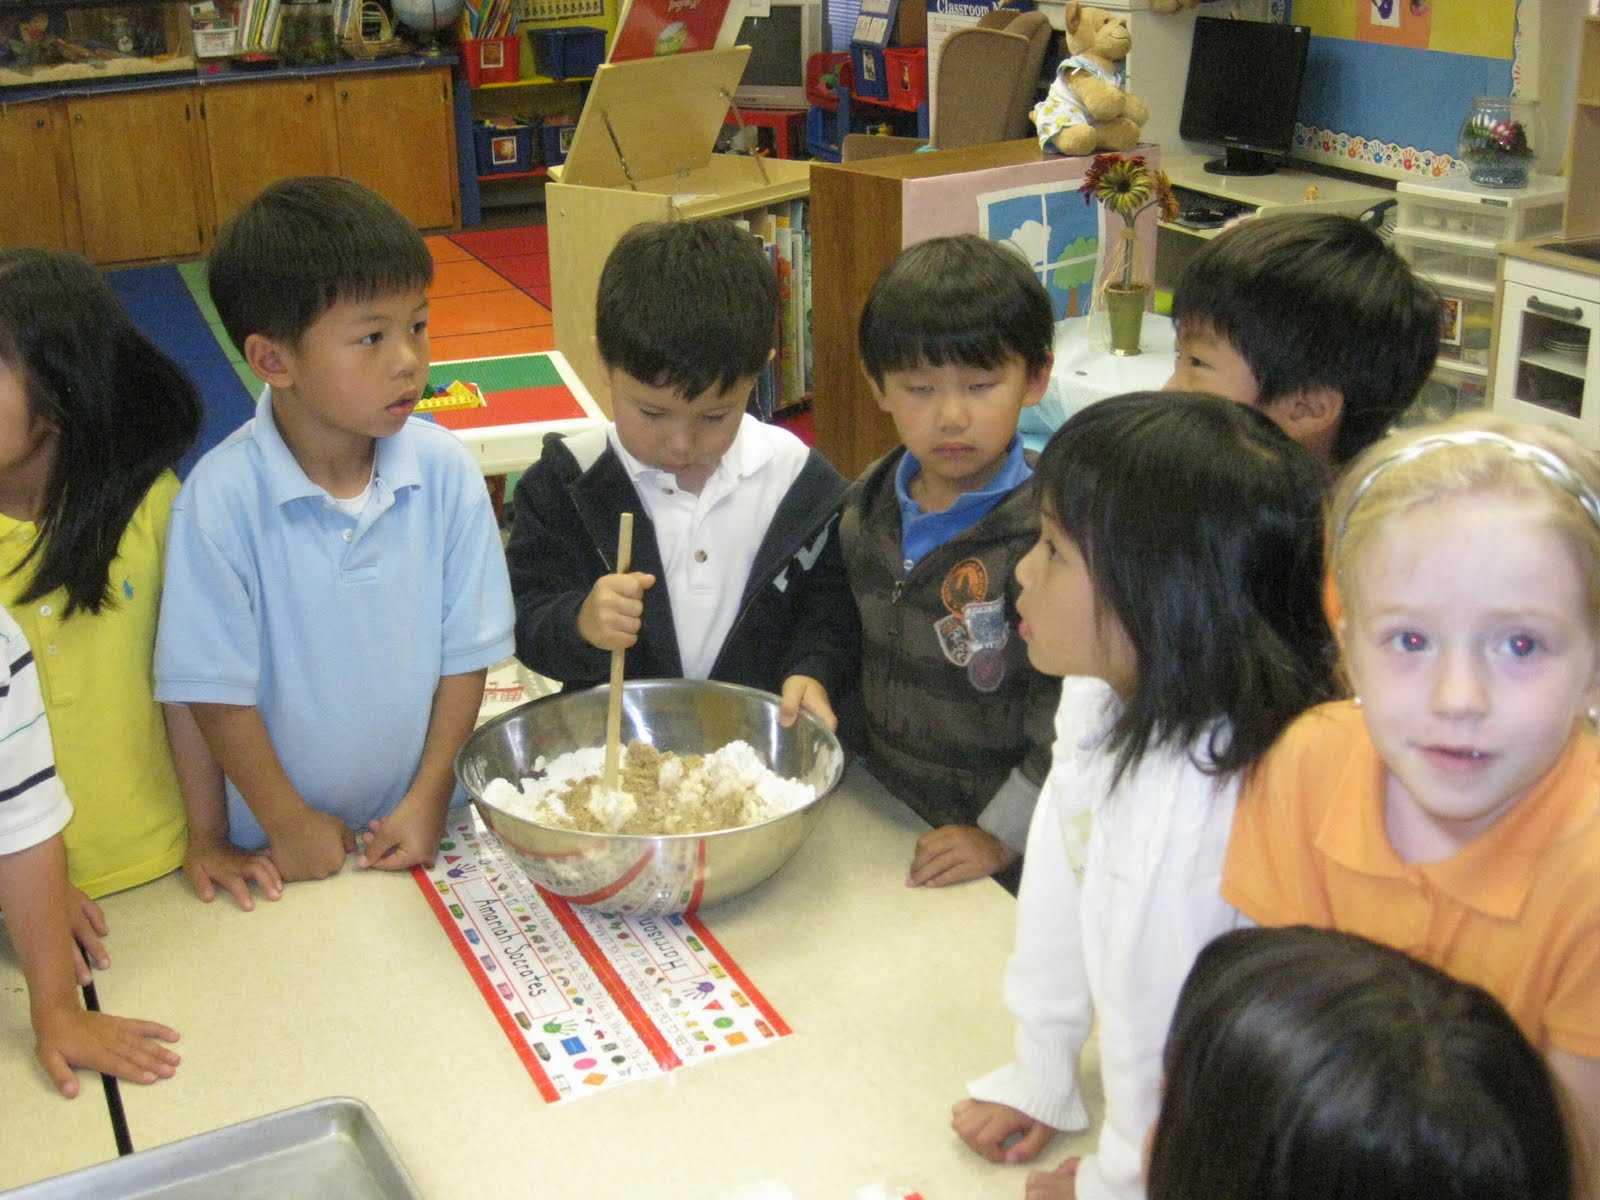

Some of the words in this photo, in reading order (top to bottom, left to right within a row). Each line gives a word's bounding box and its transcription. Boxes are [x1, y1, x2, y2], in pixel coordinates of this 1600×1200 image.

[937, 0, 990, 17] Classroom
[474, 899, 521, 944] Amariah
[504, 943, 550, 997] Socrates
[638, 917, 687, 972] Harrison
